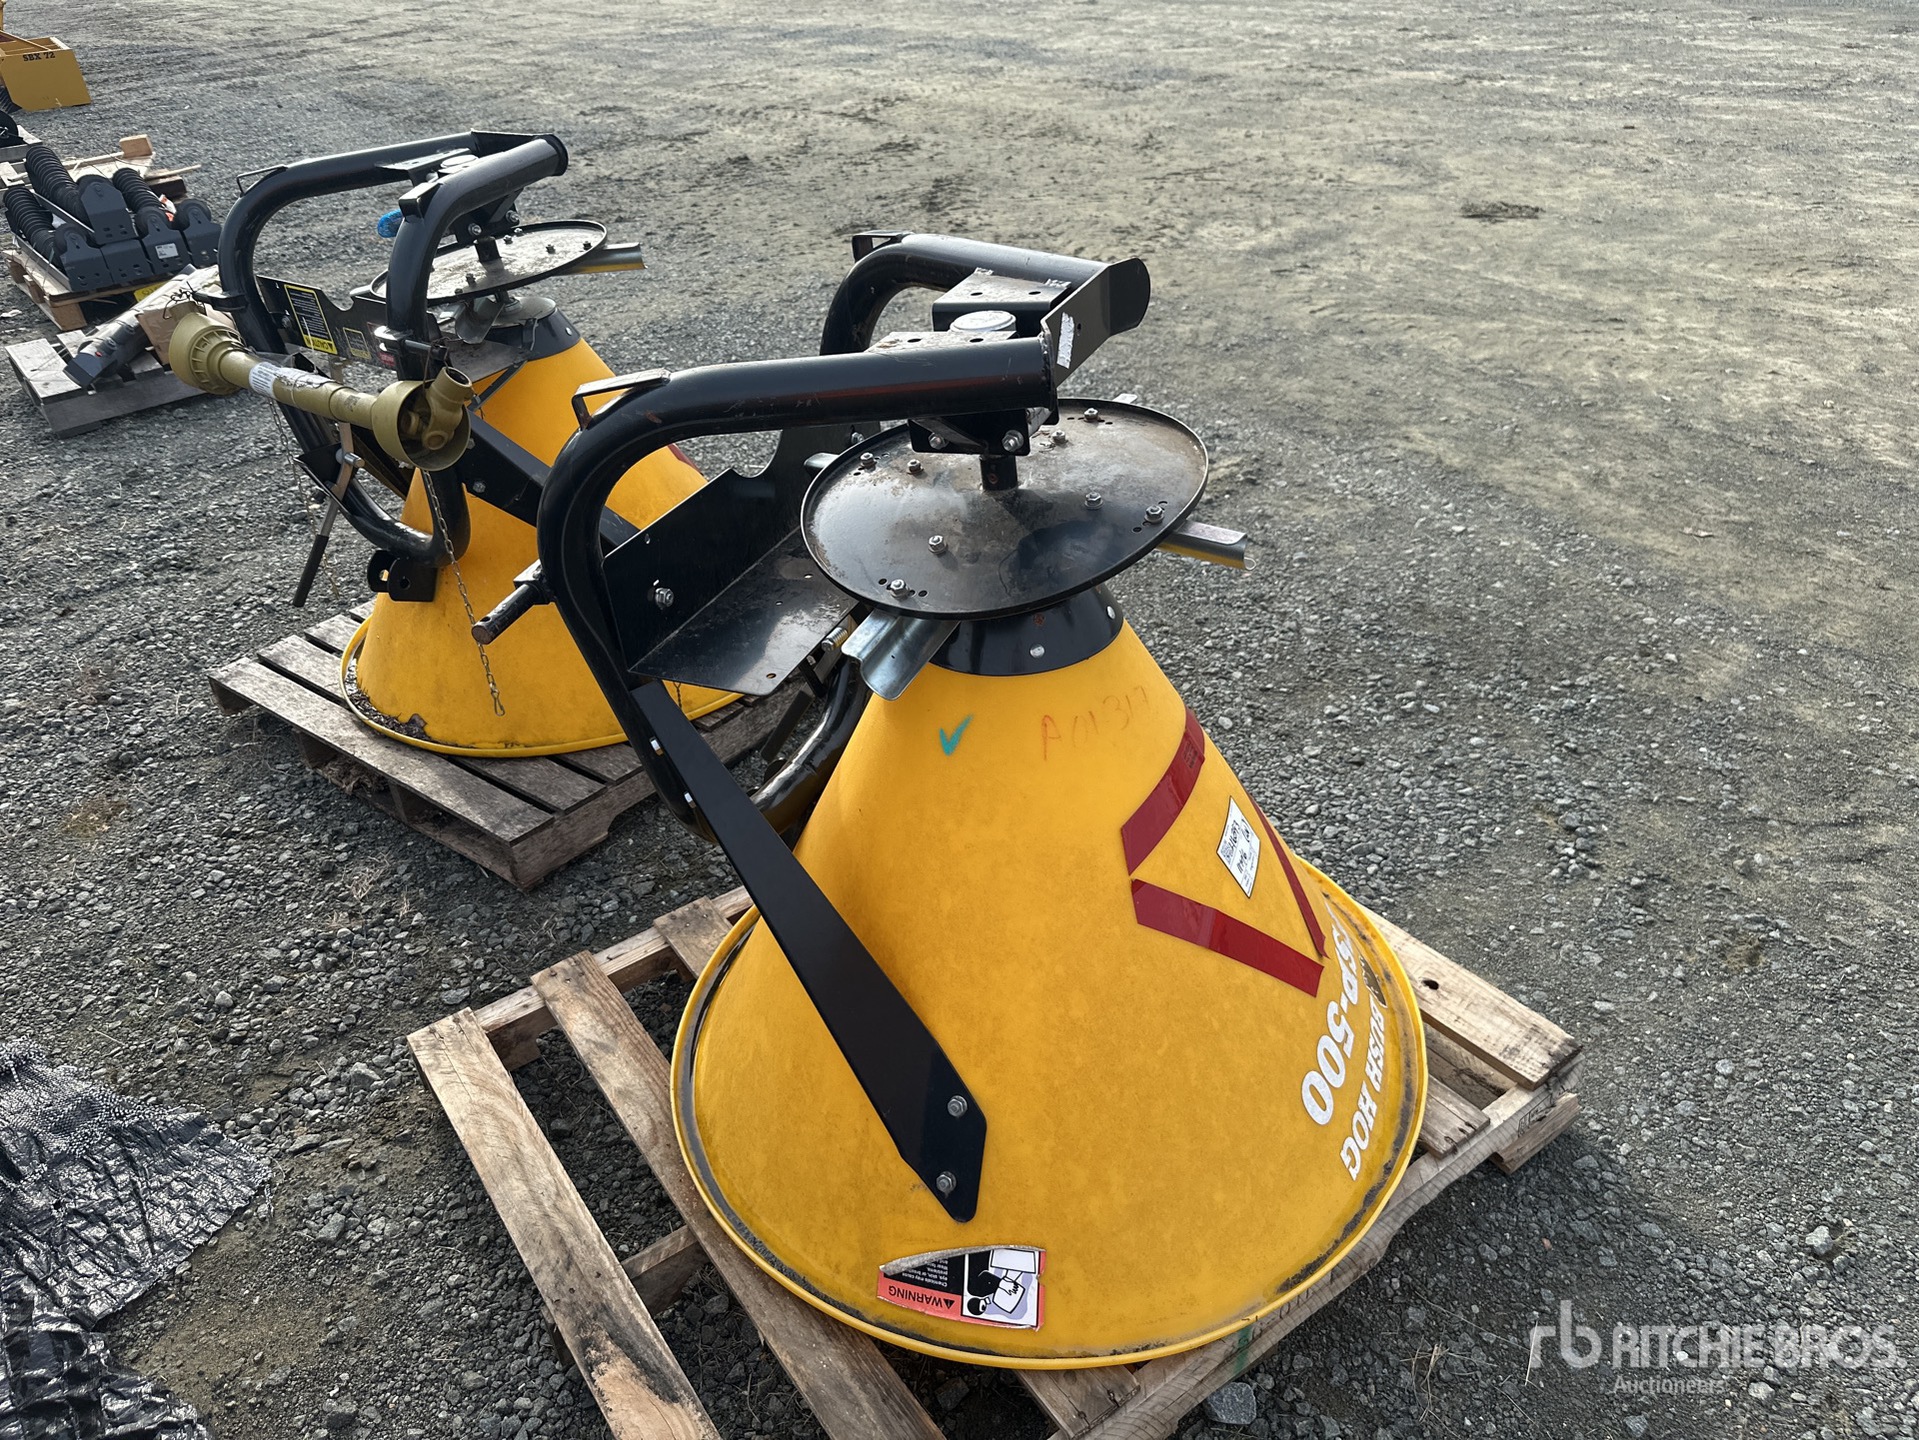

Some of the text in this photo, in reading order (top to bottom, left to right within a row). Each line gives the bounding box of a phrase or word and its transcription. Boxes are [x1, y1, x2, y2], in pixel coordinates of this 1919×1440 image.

[23, 52, 56, 62] SBX 72
[1339, 994, 1385, 1181] BUSH HOG
[889, 1286, 943, 1308] WARNING
